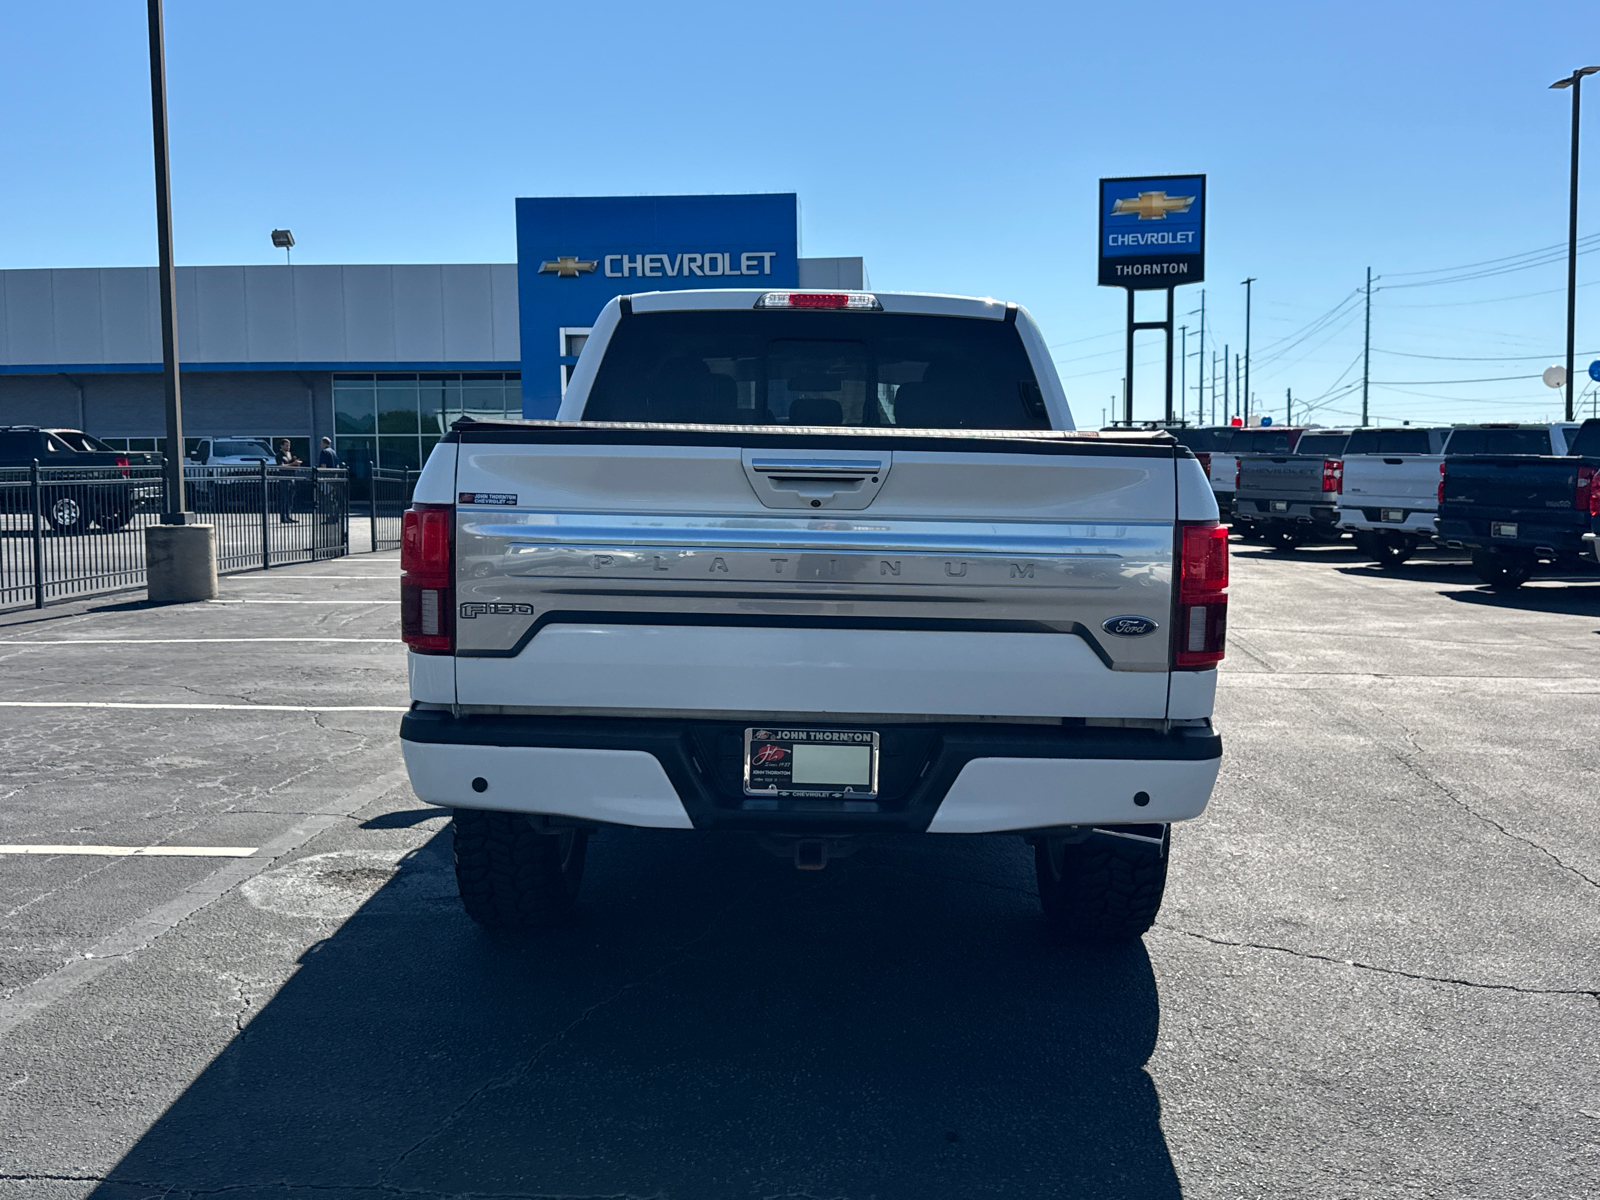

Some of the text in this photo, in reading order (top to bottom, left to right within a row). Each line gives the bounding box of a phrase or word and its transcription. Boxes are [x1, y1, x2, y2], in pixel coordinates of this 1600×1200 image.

[1108, 231, 1195, 246] CHEVROLET
[604, 252, 776, 278] CHEVROLET
[1115, 262, 1188, 276] THORNTON
[594, 554, 1035, 579] PLATINUM
[1115, 619, 1147, 633] Ford
[776, 731, 807, 740] JOHN
[809, 732, 871, 742] THORNTON
